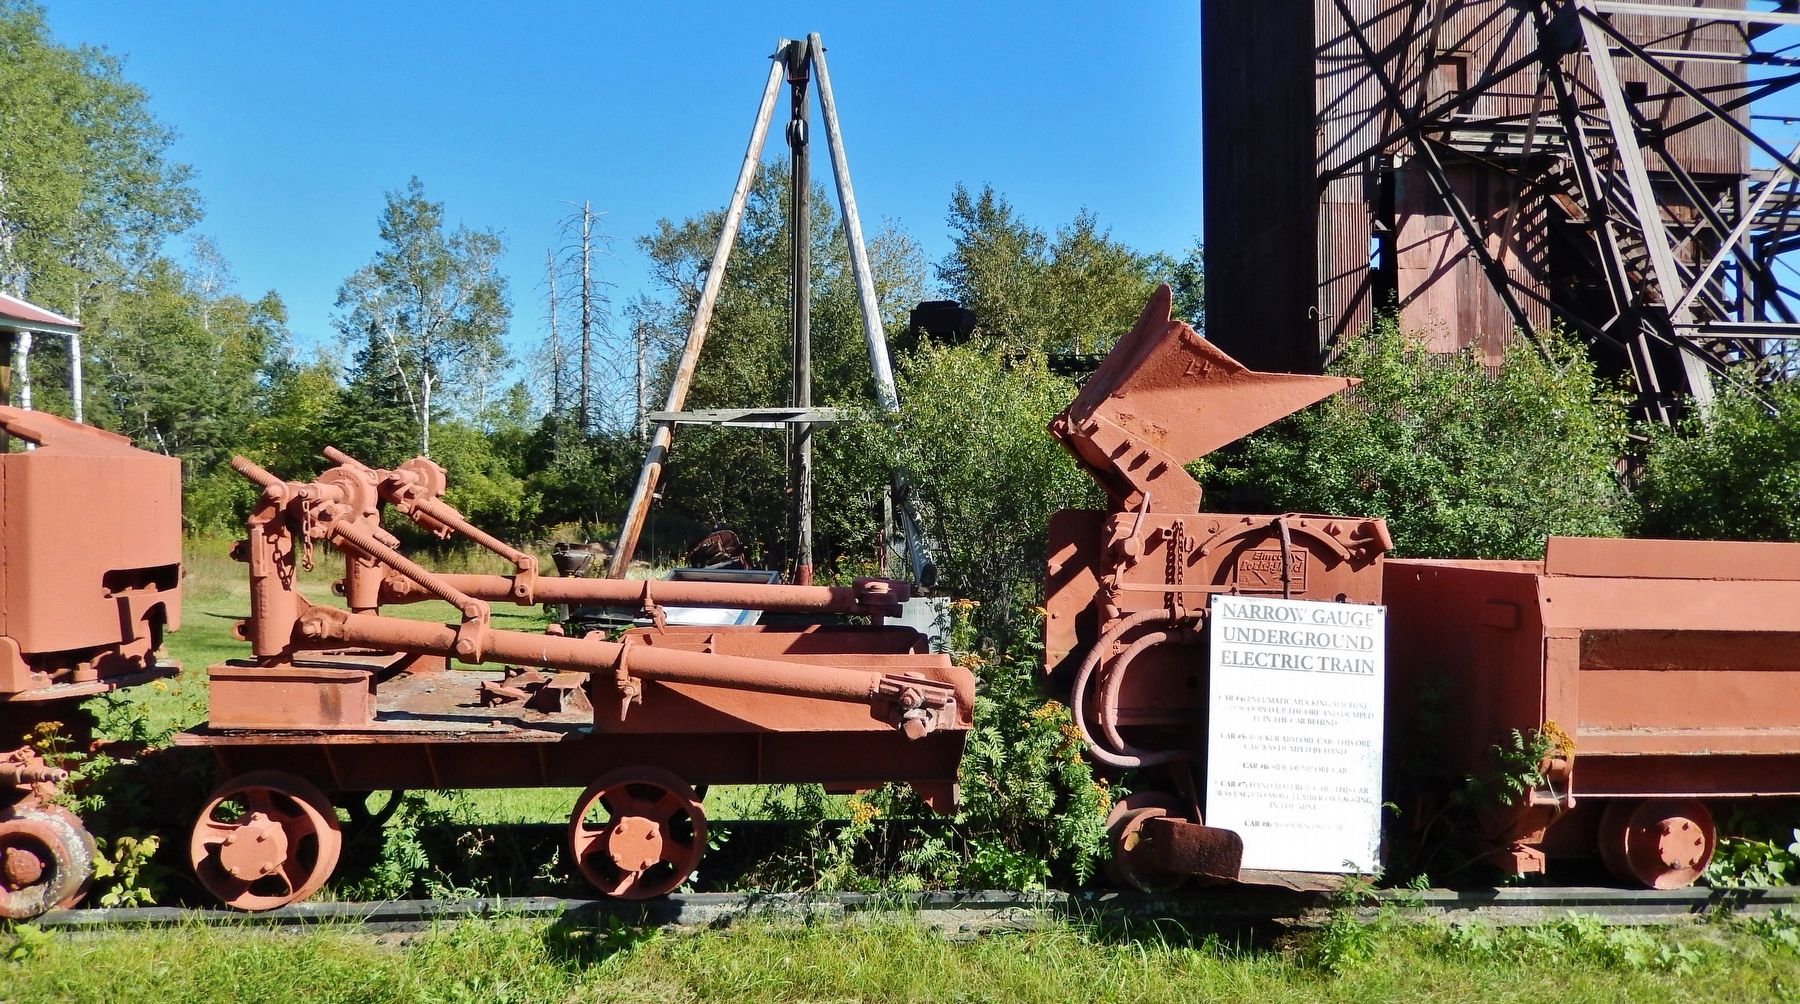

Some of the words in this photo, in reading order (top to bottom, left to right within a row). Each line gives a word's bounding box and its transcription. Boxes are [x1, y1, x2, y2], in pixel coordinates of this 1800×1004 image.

[1223, 603, 1307, 622] NARROW
[1312, 609, 1374, 627] GAUGE
[1223, 626, 1374, 650] UNDERGROUND
[1221, 650, 1313, 670] ELECTRIC
[1317, 656, 1374, 673] TRAIN
[1220, 732, 1236, 740] CAR
[1220, 780, 1236, 788] CAR
